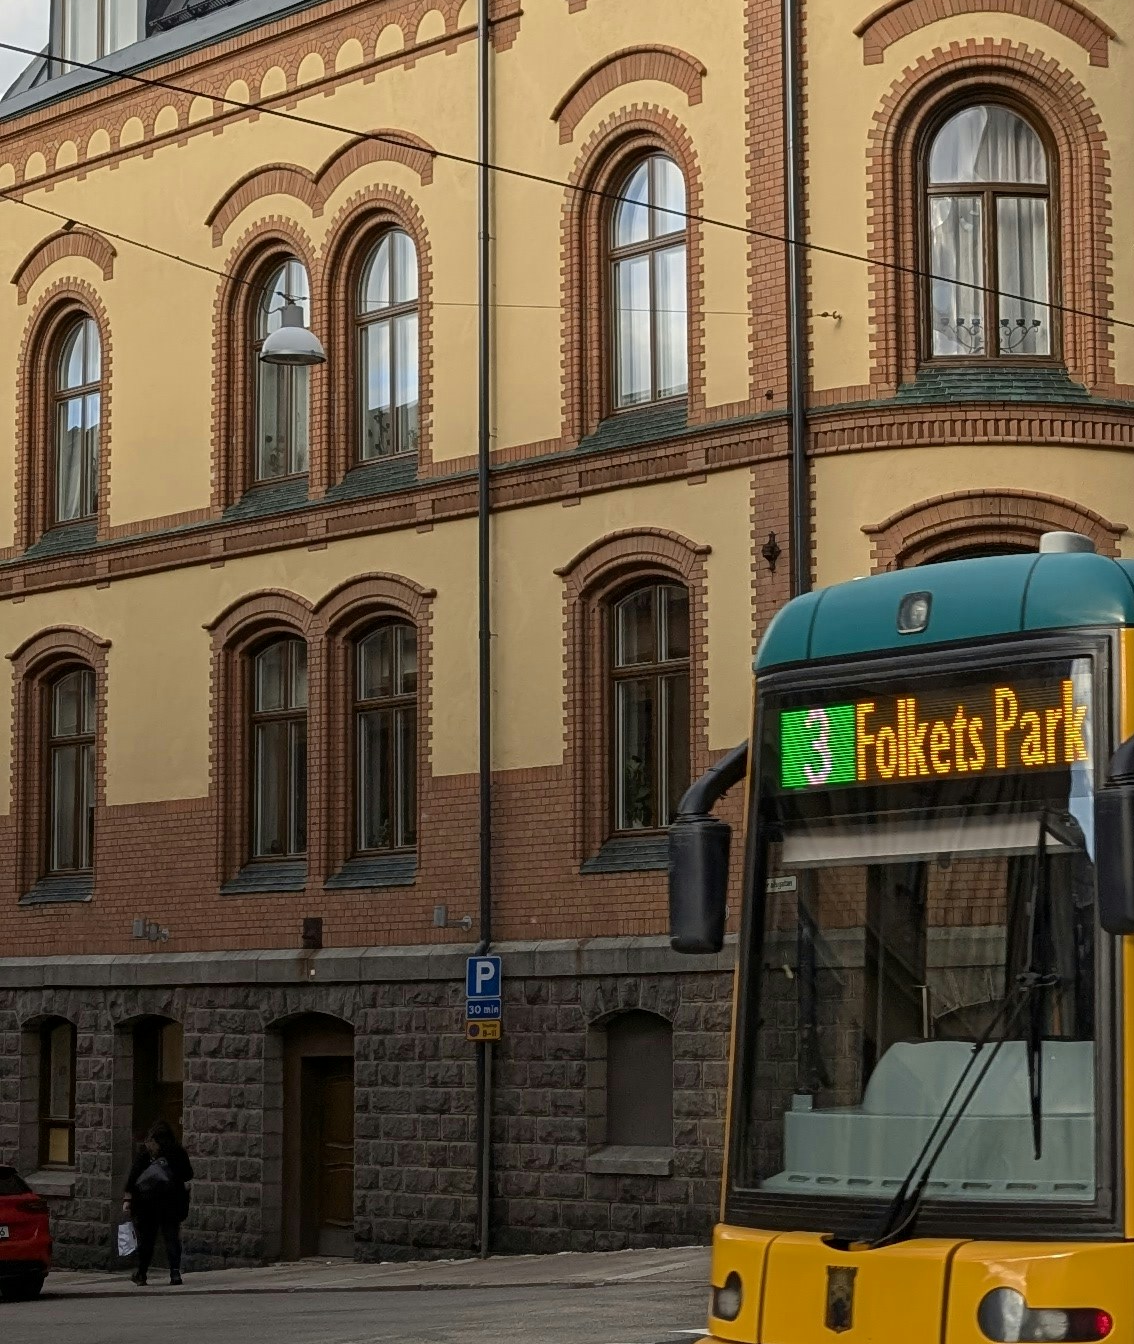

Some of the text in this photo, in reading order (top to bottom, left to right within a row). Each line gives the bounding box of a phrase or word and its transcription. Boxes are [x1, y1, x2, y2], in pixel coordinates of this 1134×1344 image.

[804, 681, 1089, 784] 3 Folkets Park
[476, 961, 495, 993] P
[468, 1004, 499, 1014] 30 min
